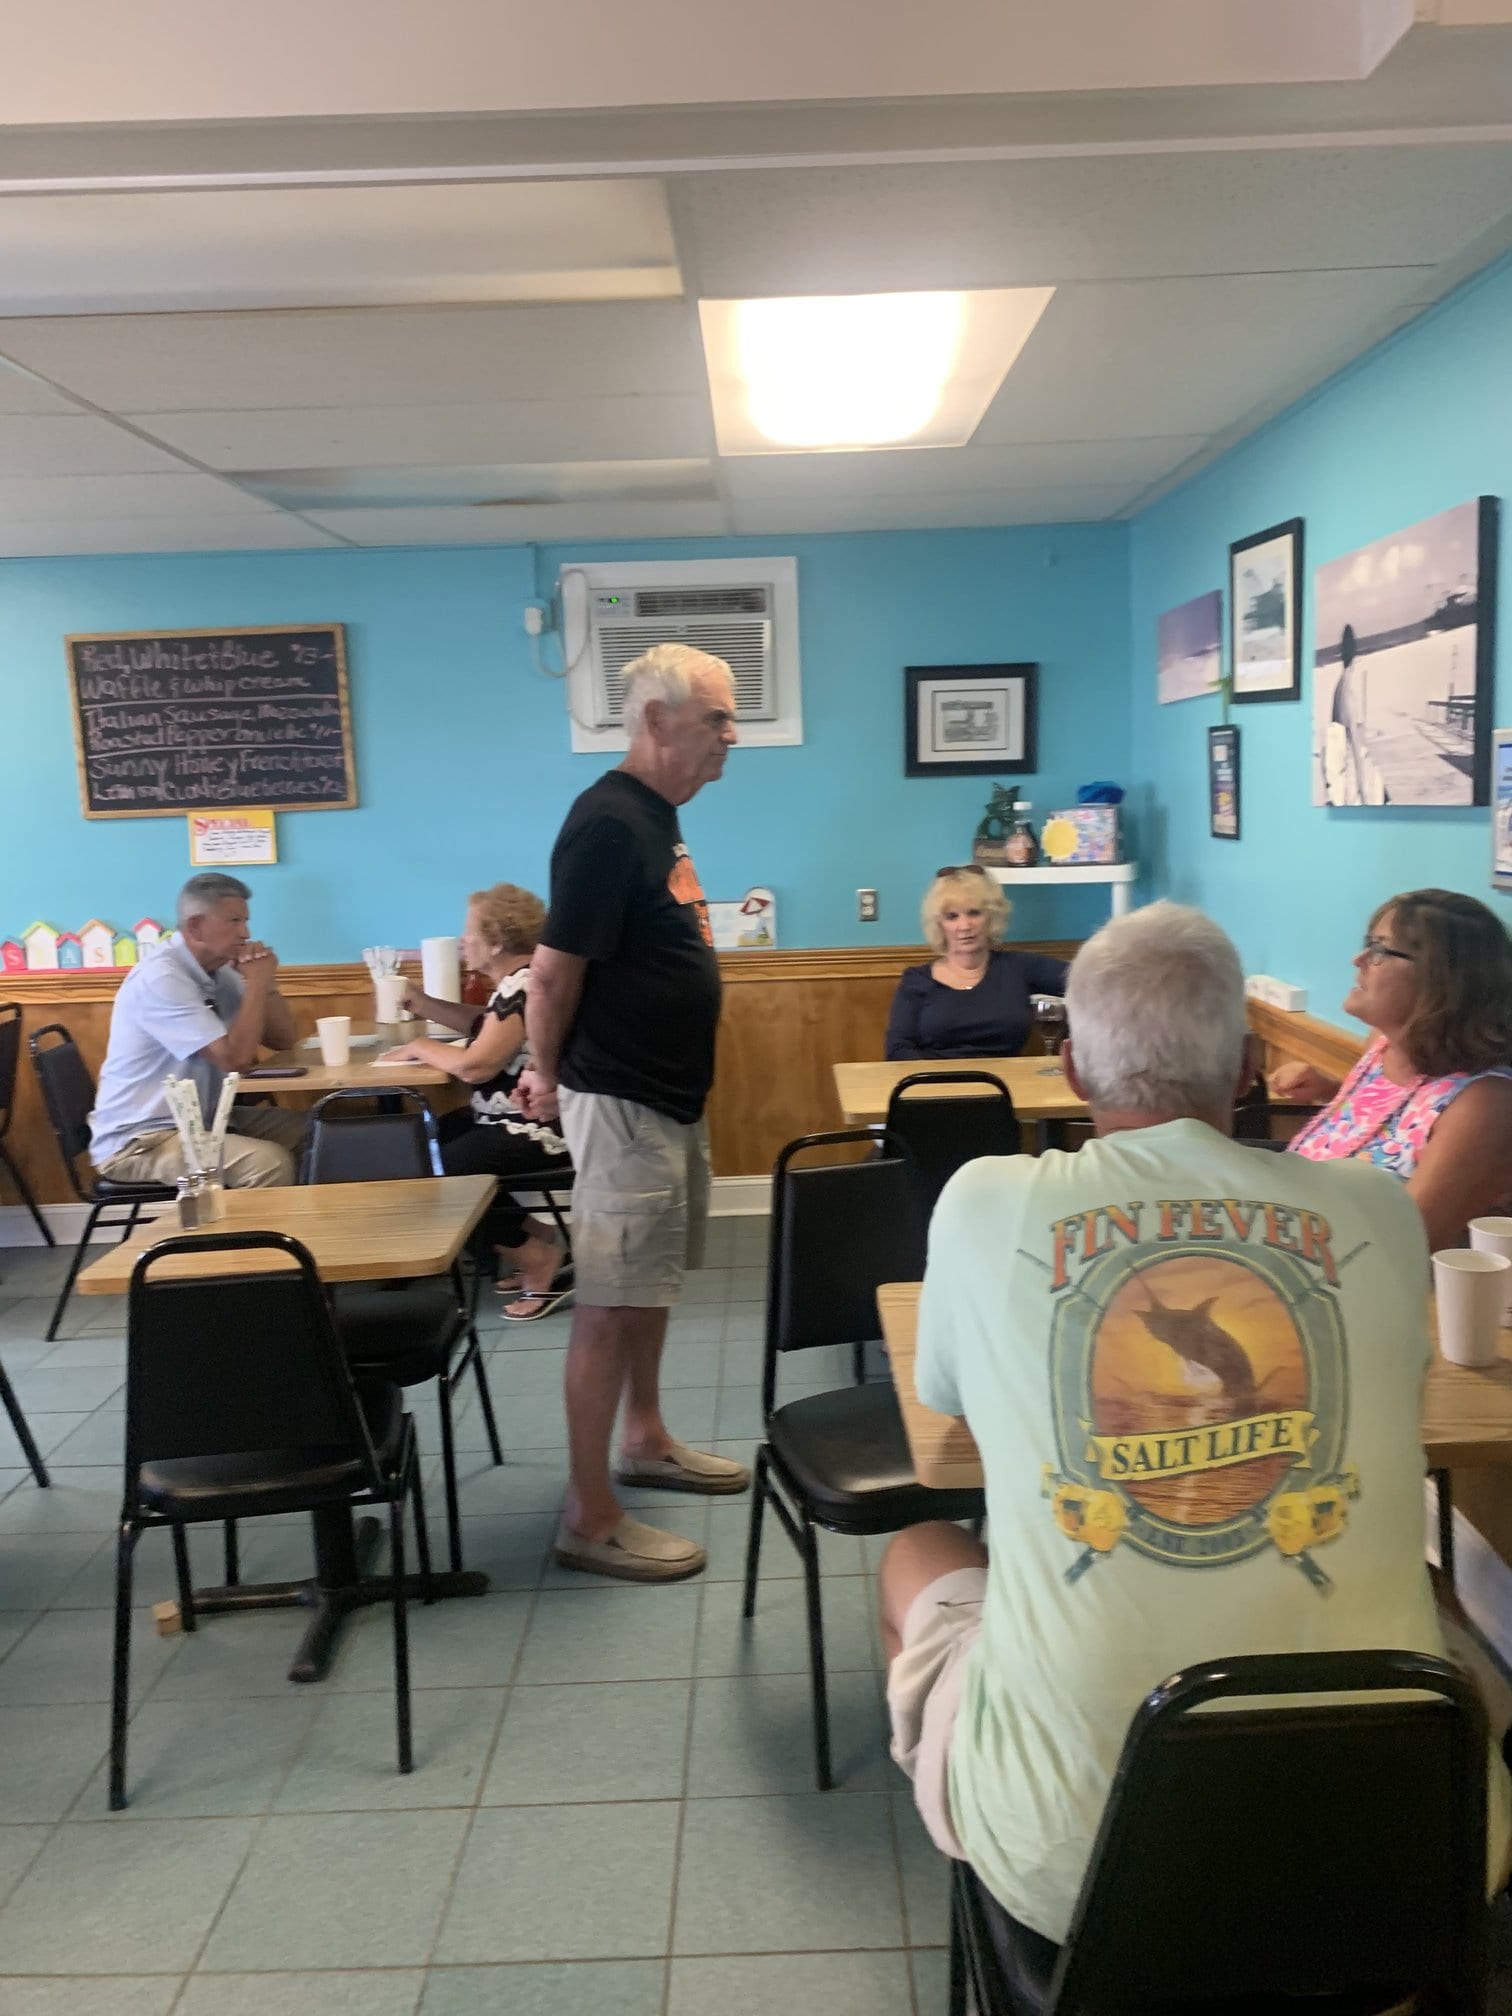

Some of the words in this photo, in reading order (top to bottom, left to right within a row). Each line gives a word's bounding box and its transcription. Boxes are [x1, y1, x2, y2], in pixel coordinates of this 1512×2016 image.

[80, 674, 165, 699] Waffle
[83, 707, 163, 729] Italian
[1050, 1200, 1145, 1294] FIN
[1155, 1198, 1342, 1289] FEVER
[1110, 1435, 1203, 1476] SALT
[1205, 1416, 1294, 1463] LIFE
